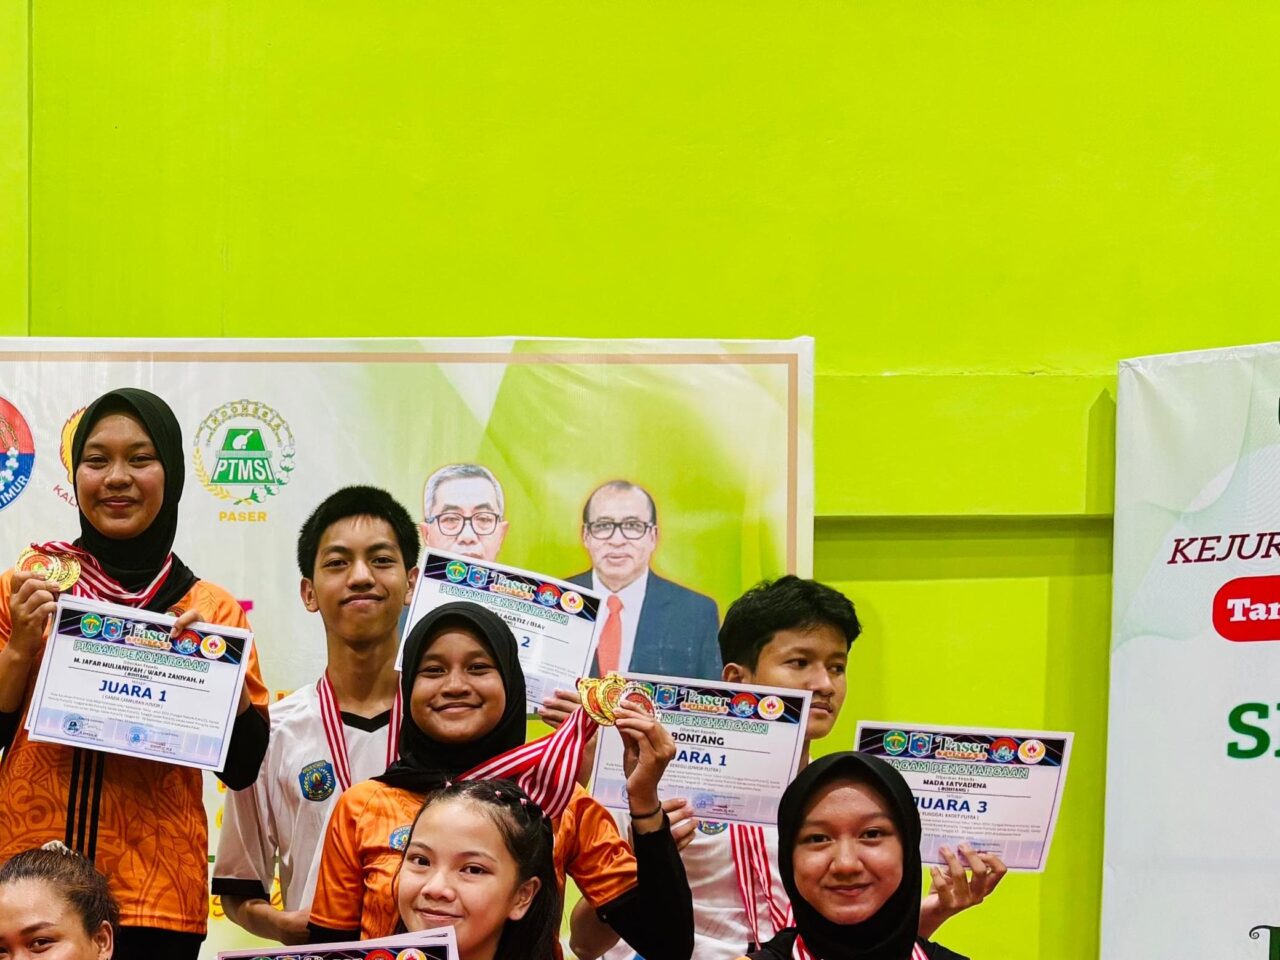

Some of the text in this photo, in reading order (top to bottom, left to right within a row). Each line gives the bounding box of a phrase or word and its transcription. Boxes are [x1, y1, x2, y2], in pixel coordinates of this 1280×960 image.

[215, 457, 274, 481] PTMSI
[219, 511, 268, 522] PASER
[521, 636, 531, 649] 2
[99, 680, 167, 701] JUARA 1
[680, 687, 731, 706] Paser
[935, 736, 990, 753] Paser
[718, 754, 727, 767] 1
[885, 759, 930, 773] AGAM
[931, 761, 1030, 779] PENGHARGAAN
[977, 801, 988, 813] 3
